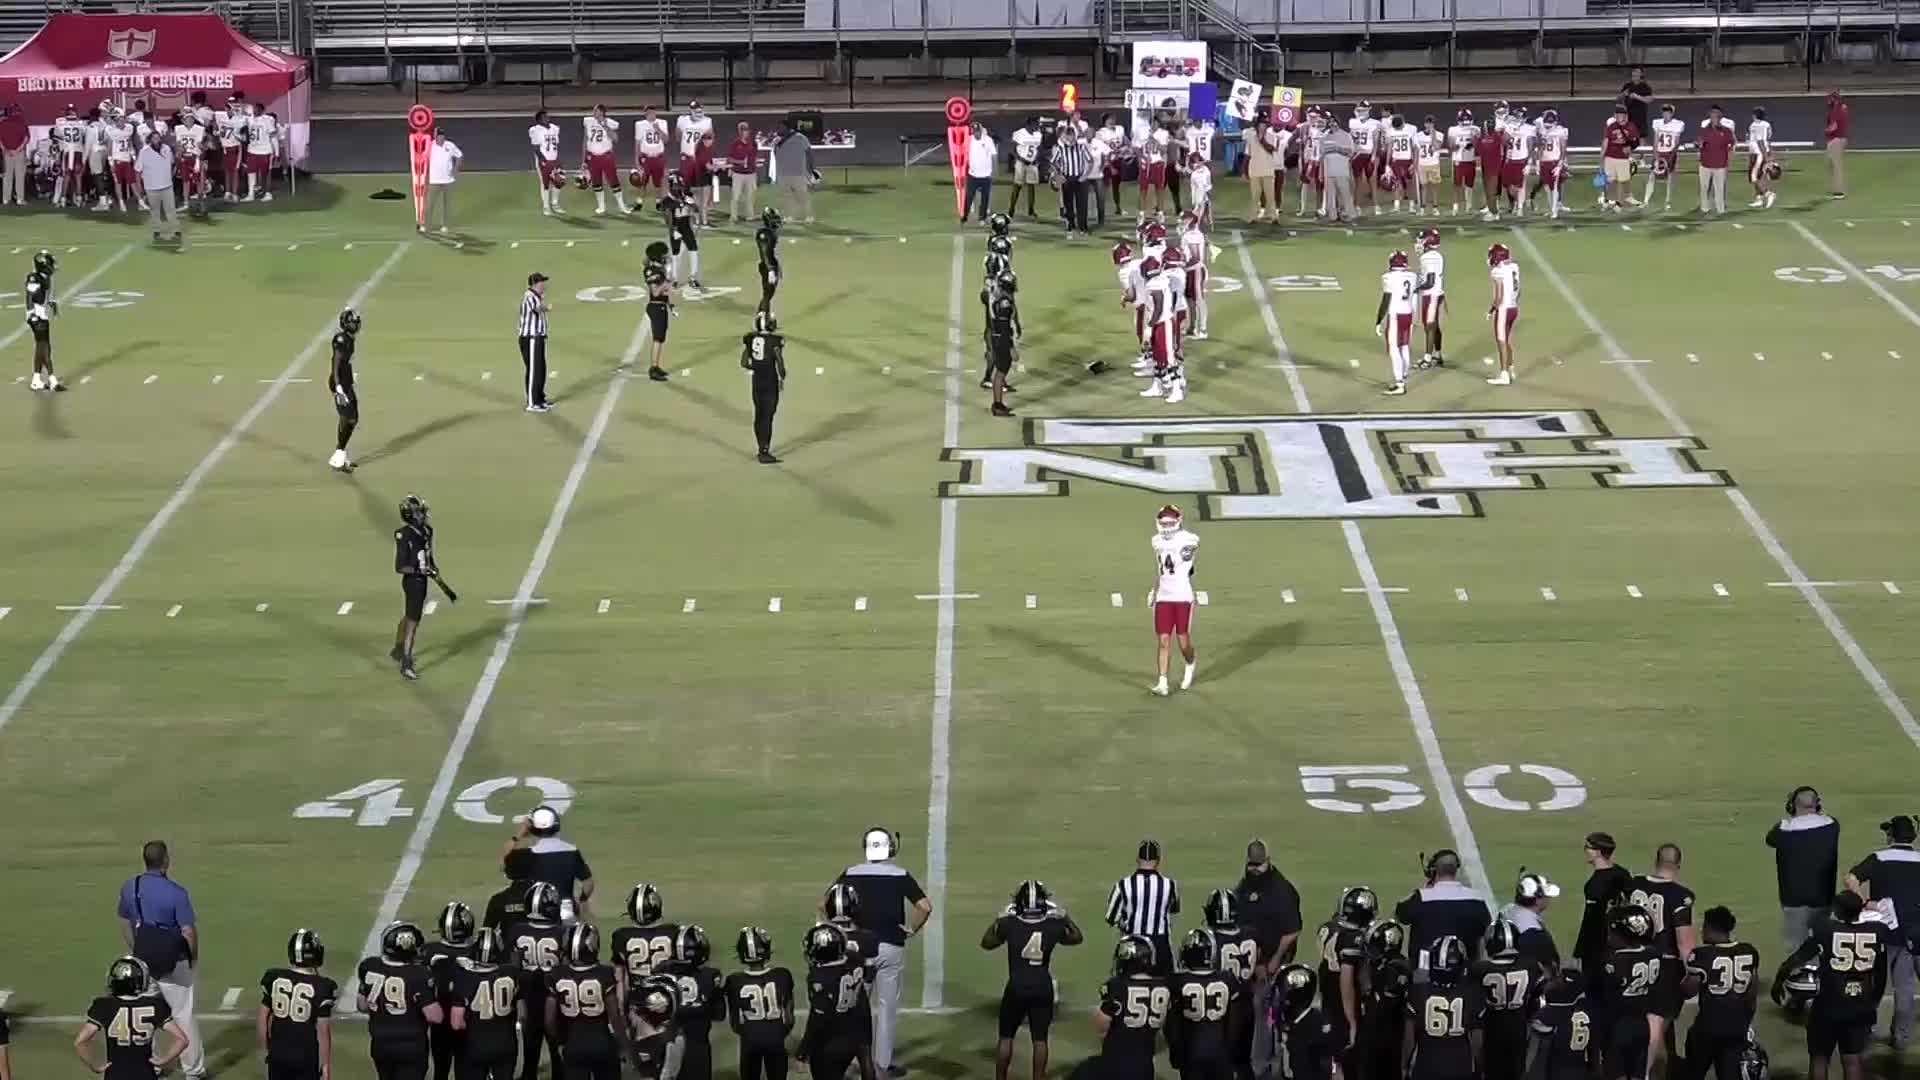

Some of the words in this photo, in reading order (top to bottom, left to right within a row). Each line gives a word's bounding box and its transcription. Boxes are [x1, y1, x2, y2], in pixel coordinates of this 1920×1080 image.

[18, 76, 84, 92] BROTHER
[89, 74, 145, 89] MARTIN
[150, 73, 233, 89] CRUSADERS
[1063, 84, 1076, 110] 2
[63, 127, 80, 142] 52
[1393, 138, 1408, 152] 38
[752, 336, 765, 360] 9
[516, 935, 560, 972] 36
[626, 935, 672, 976] 22
[1021, 931, 1043, 965] 4
[1829, 931, 1877, 972] 55
[365, 971, 407, 1015] 79
[1482, 969, 1529, 1010] 37
[1708, 954, 1753, 995] 35
[271, 976, 315, 1023] 66
[470, 976, 515, 1020] 40
[556, 978, 605, 1017] 39
[739, 981, 782, 1021] 31
[1124, 986, 1172, 1029] 59
[1182, 981, 1229, 1022] 33
[1425, 995, 1465, 1037] 61
[108, 1006, 155, 1046] 45
[1570, 1011, 1590, 1051] 6
